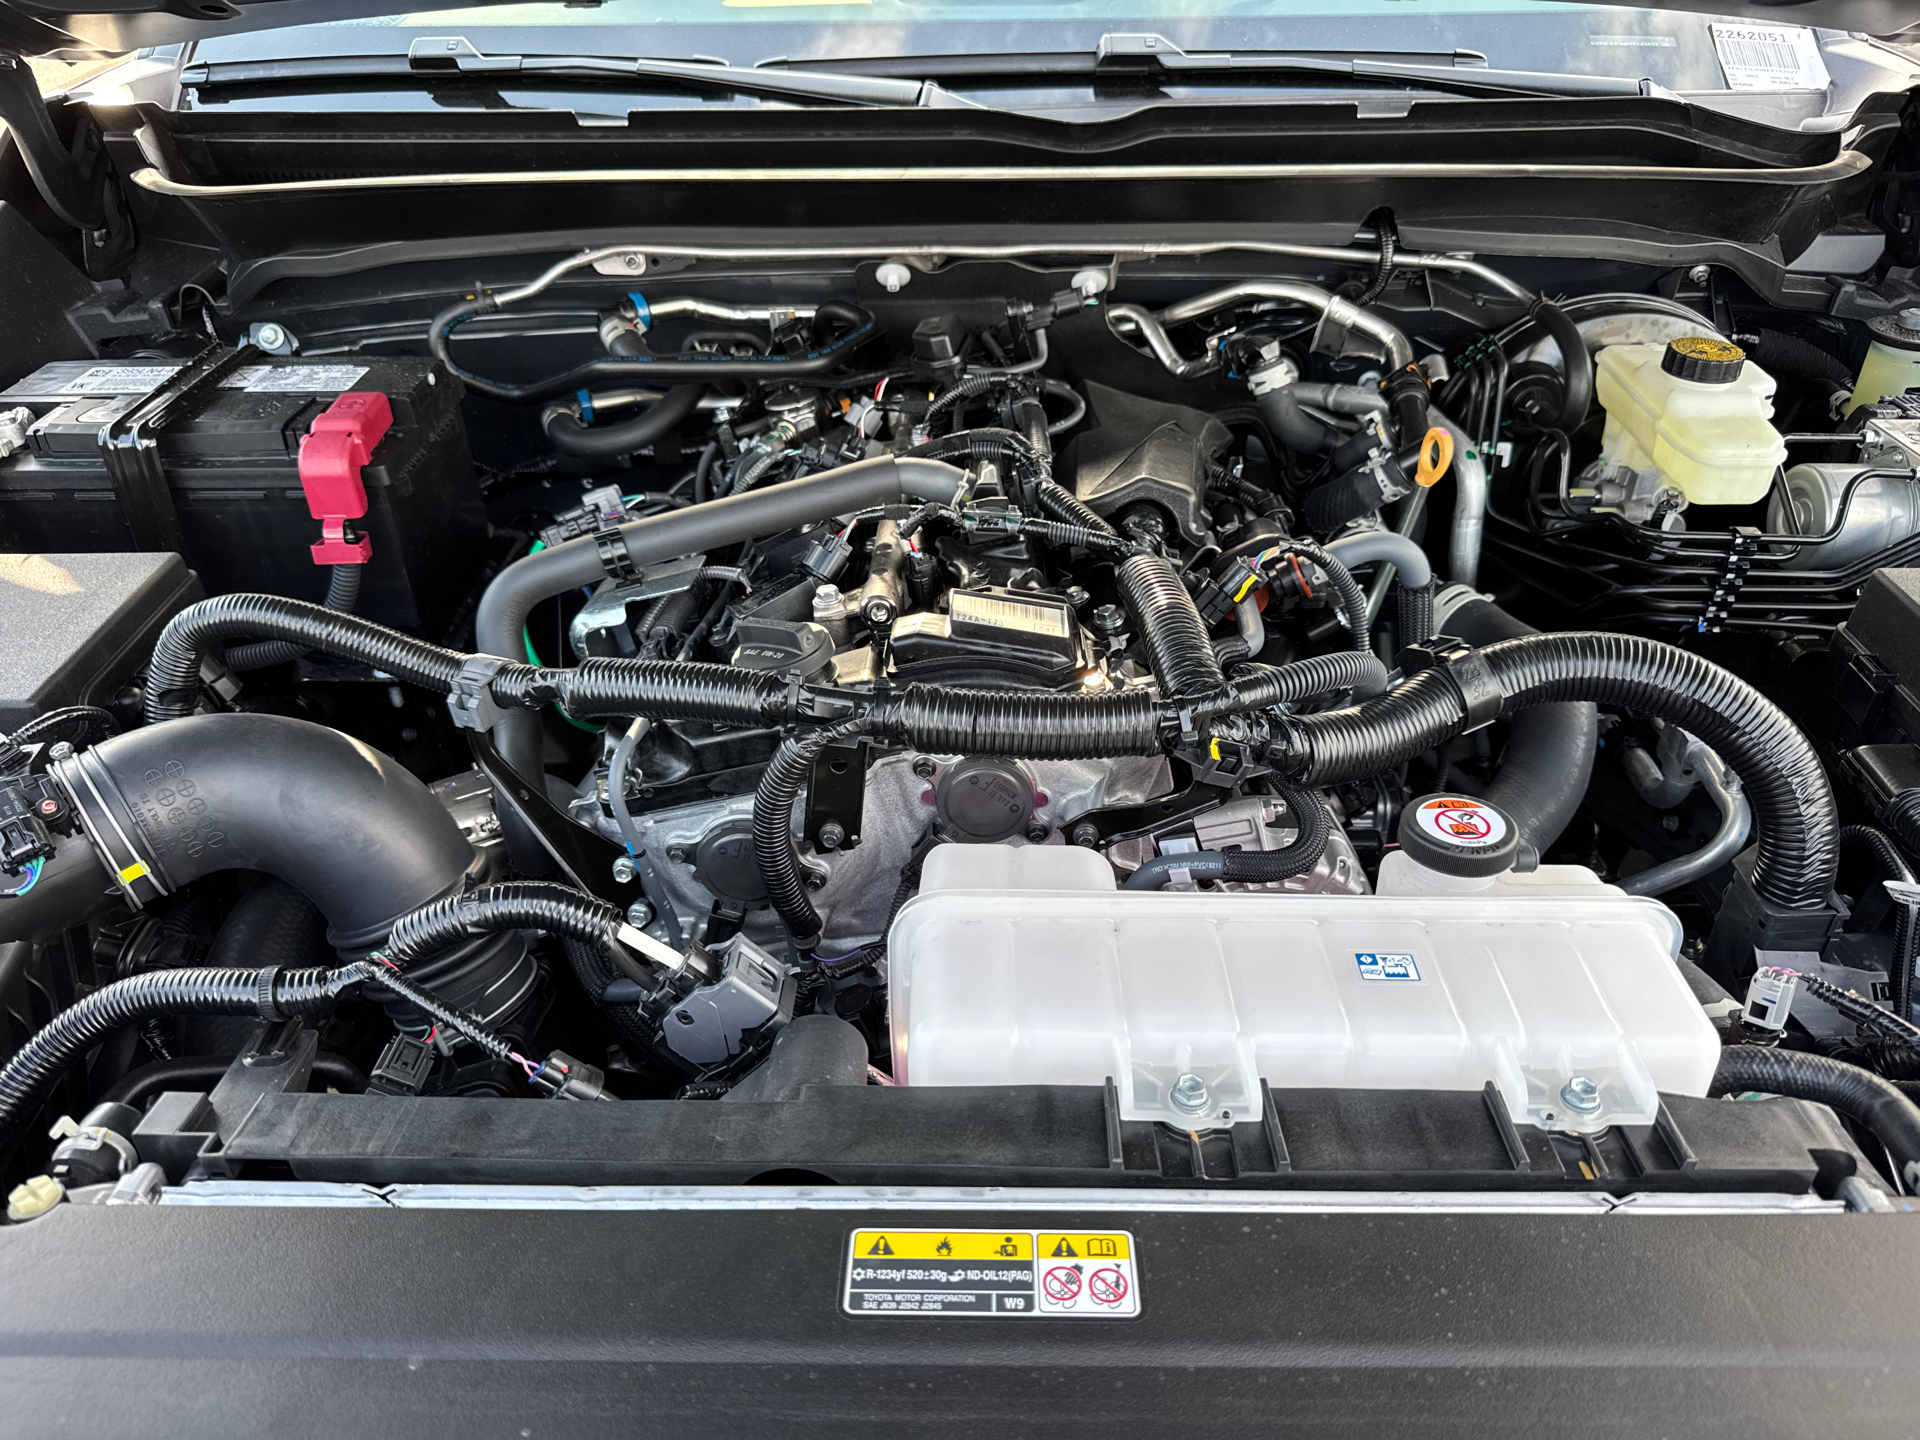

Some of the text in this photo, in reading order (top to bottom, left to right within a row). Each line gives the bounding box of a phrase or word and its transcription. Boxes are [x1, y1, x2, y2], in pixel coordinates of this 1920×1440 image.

[1715, 29, 1789, 43] 2262051
[761, 651, 785, 659] 0W-20
[866, 1268, 1033, 1283] R-1234yf 520±30g ND-OIL12(PAG)
[863, 1293, 976, 1303] TOYOTA MOTOR CORPORATION
[1004, 1296, 1025, 1310] W9
[862, 1301, 878, 1309] SAE
[880, 1301, 897, 1309] J639
